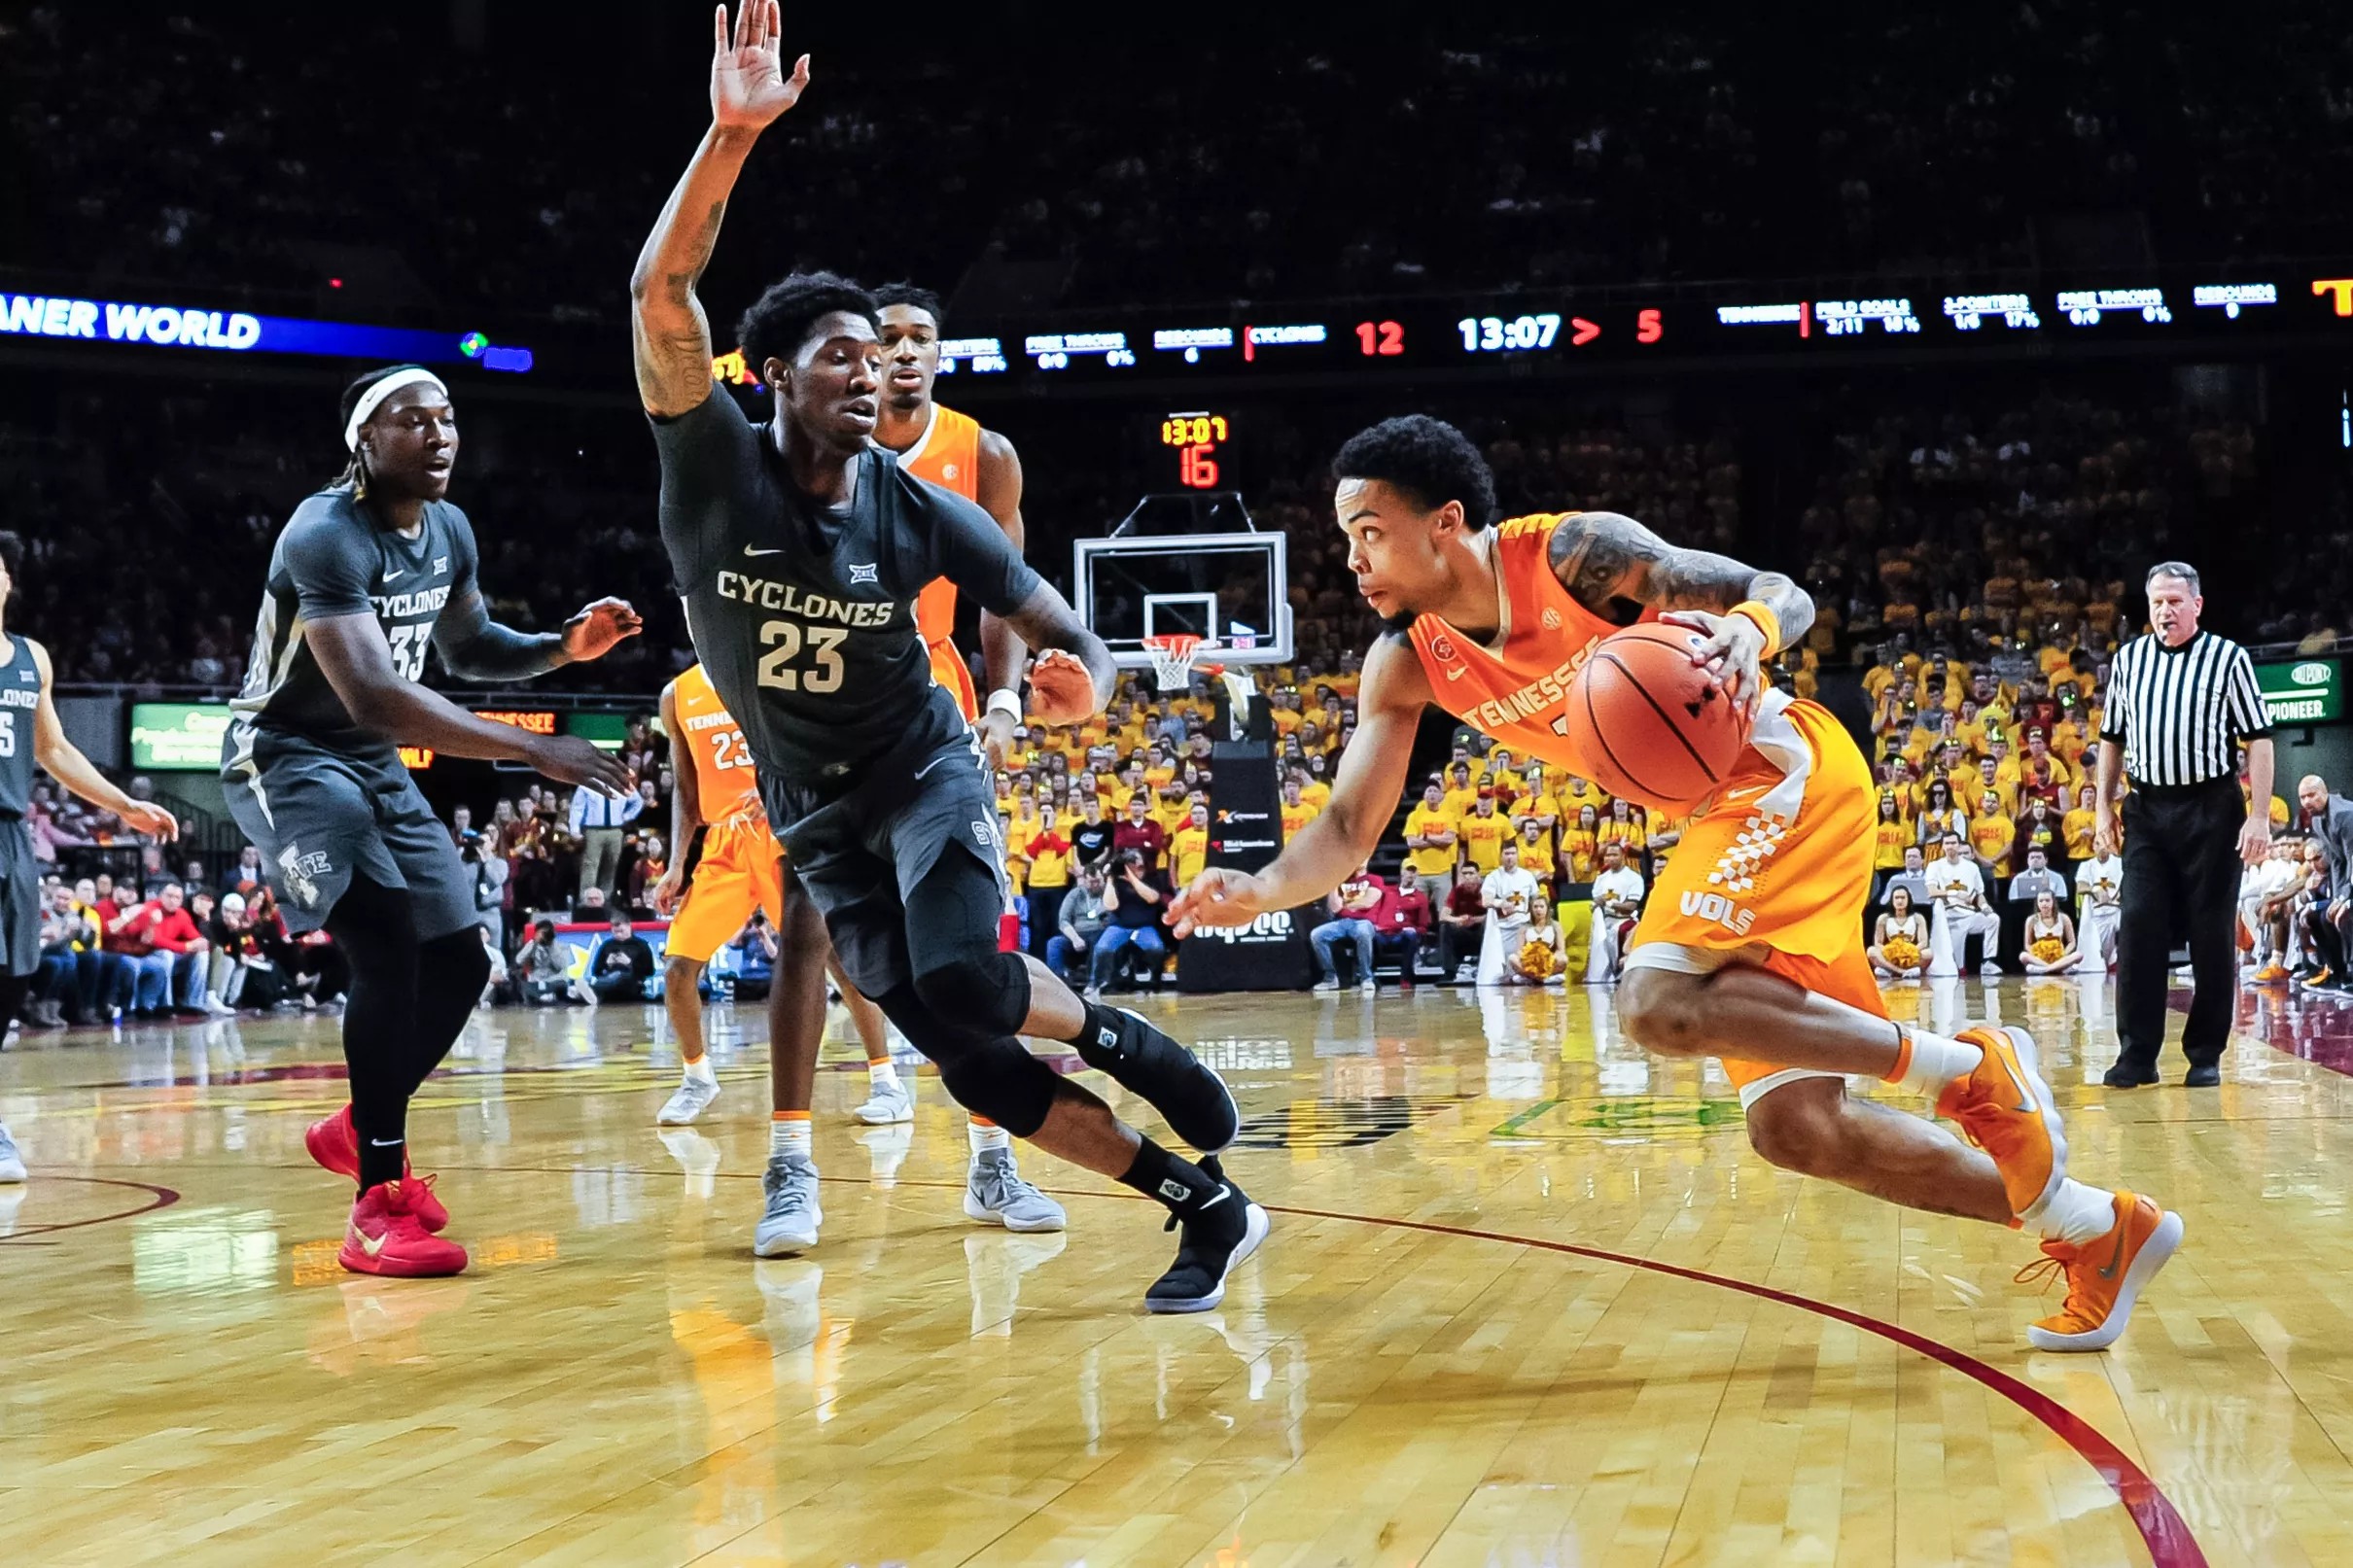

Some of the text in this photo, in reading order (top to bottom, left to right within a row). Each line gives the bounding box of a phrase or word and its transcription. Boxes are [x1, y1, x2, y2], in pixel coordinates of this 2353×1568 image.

[105, 303, 261, 350] WORLD
[1355, 321, 1404, 356] 12
[1458, 313, 1561, 352] 13:07
[1636, 309, 1662, 343] 5
[1162, 416, 1227, 446] 13:07
[1181, 443, 1218, 488] 16
[717, 570, 895, 627] CYCLONES
[390, 621, 434, 682] 33
[756, 620, 849, 693] 23
[711, 729, 755, 771] 23
[1679, 889, 1756, 936] VOLS
